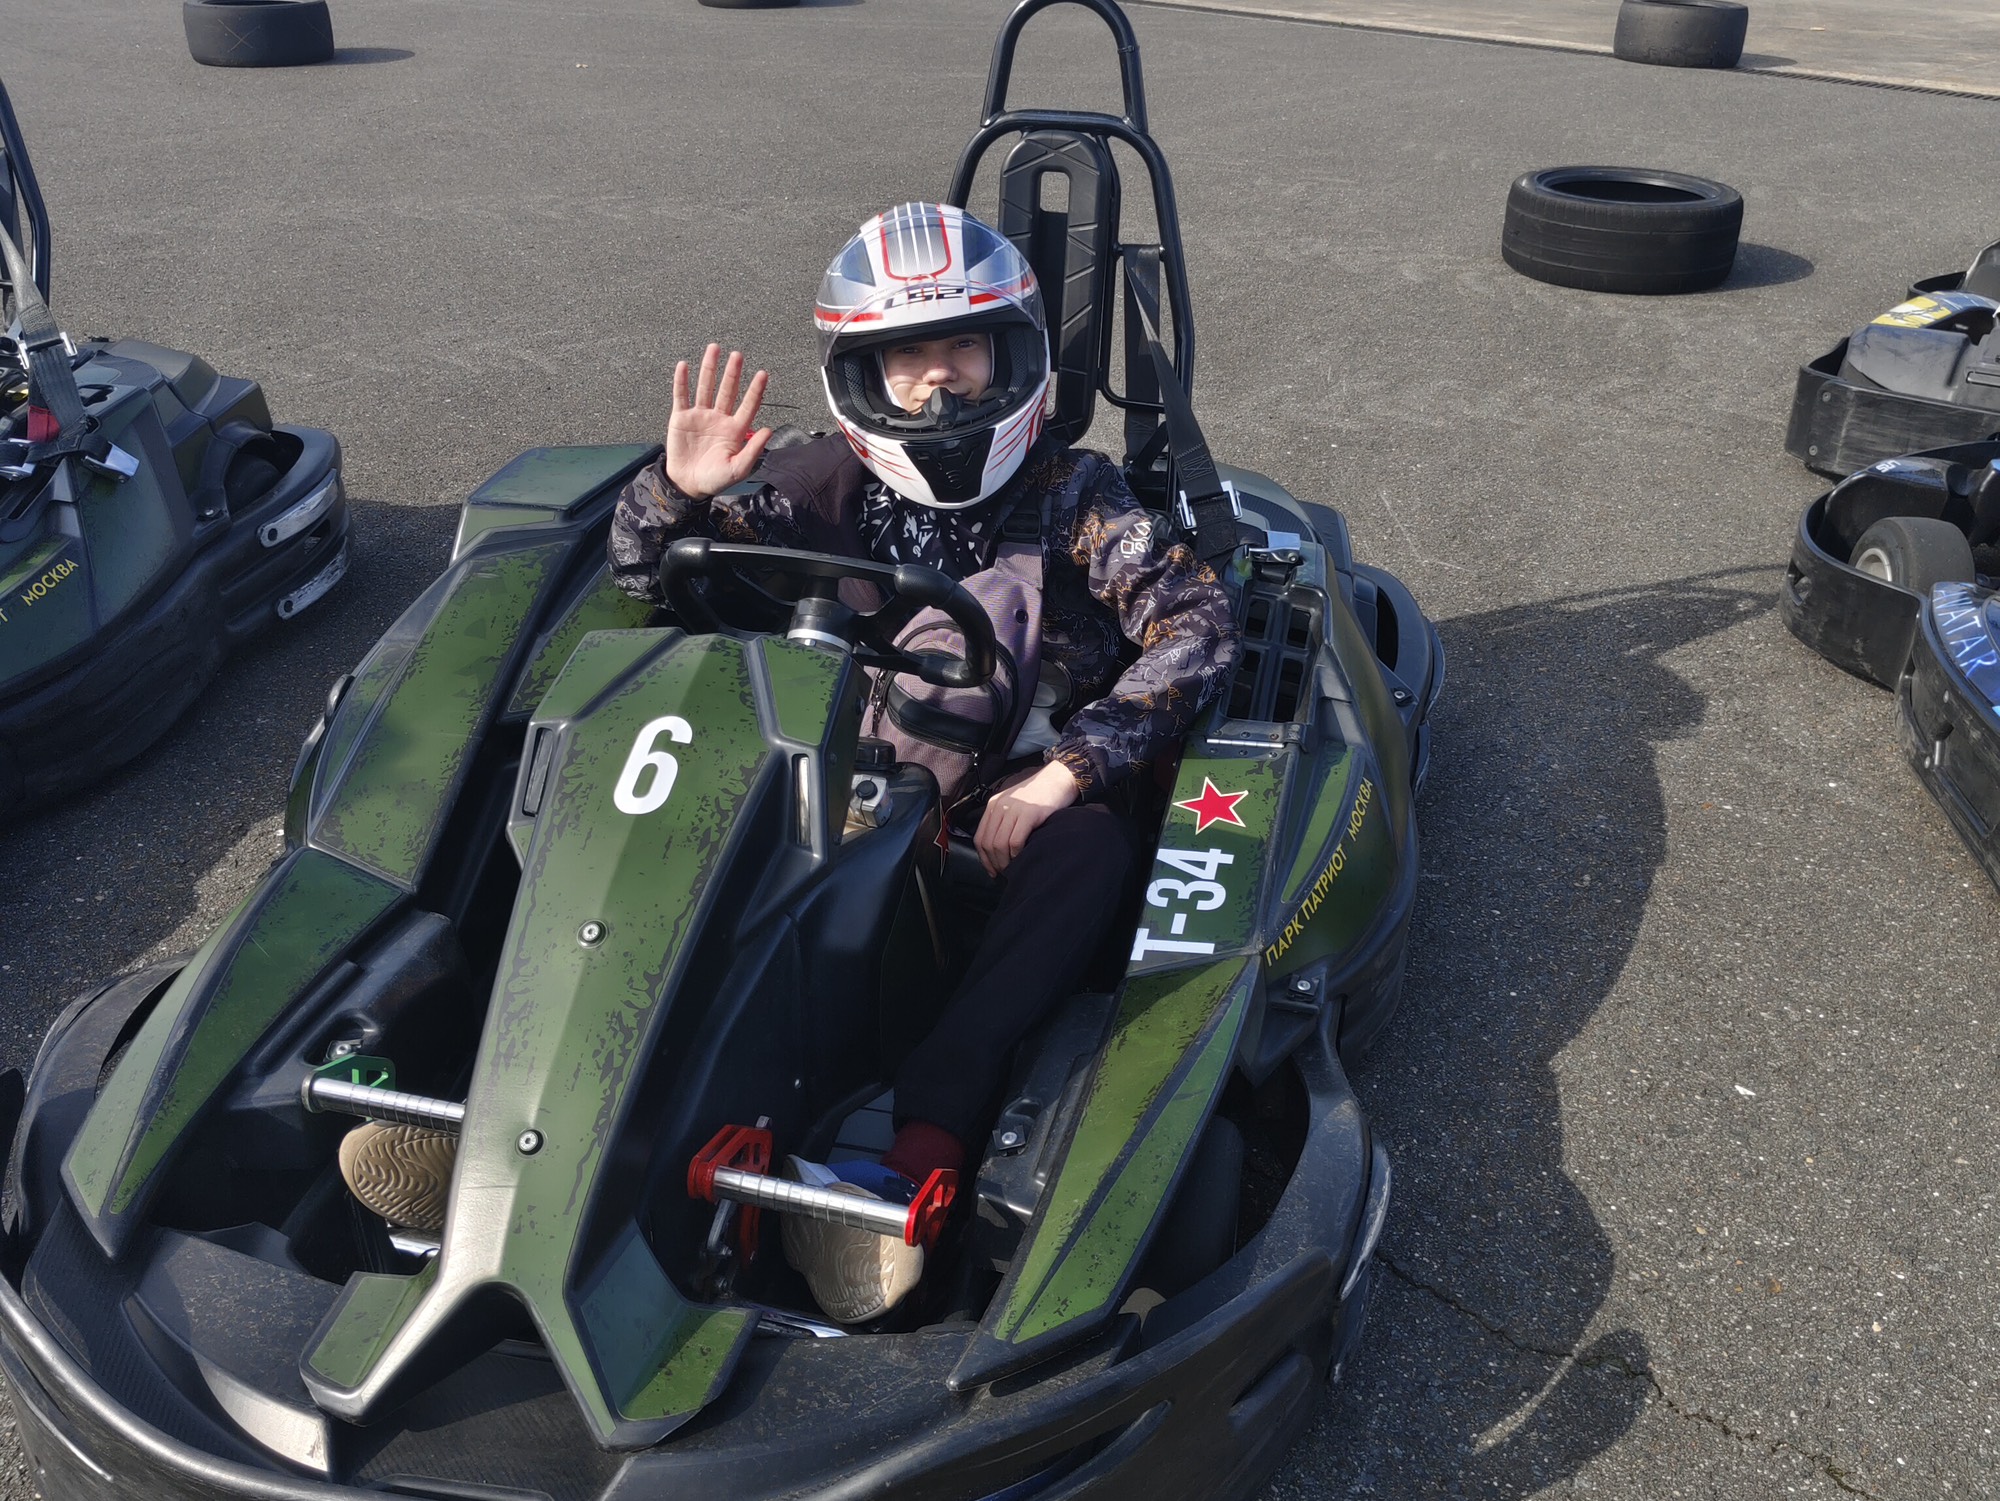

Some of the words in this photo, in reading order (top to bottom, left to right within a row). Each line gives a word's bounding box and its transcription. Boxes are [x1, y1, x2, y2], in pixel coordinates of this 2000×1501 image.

[884, 287, 966, 310] LS2
[20, 558, 79, 607] МОСКВА
[1932, 588, 1998, 679] AVATAR
[613, 715, 693, 815] 6
[1129, 848, 1235, 962] Т-34
[1265, 914, 1304, 967] ПАРК
[1300, 842, 1348, 922] ПАТРИОТ
[1346, 776, 1374, 842] МОСКВА
